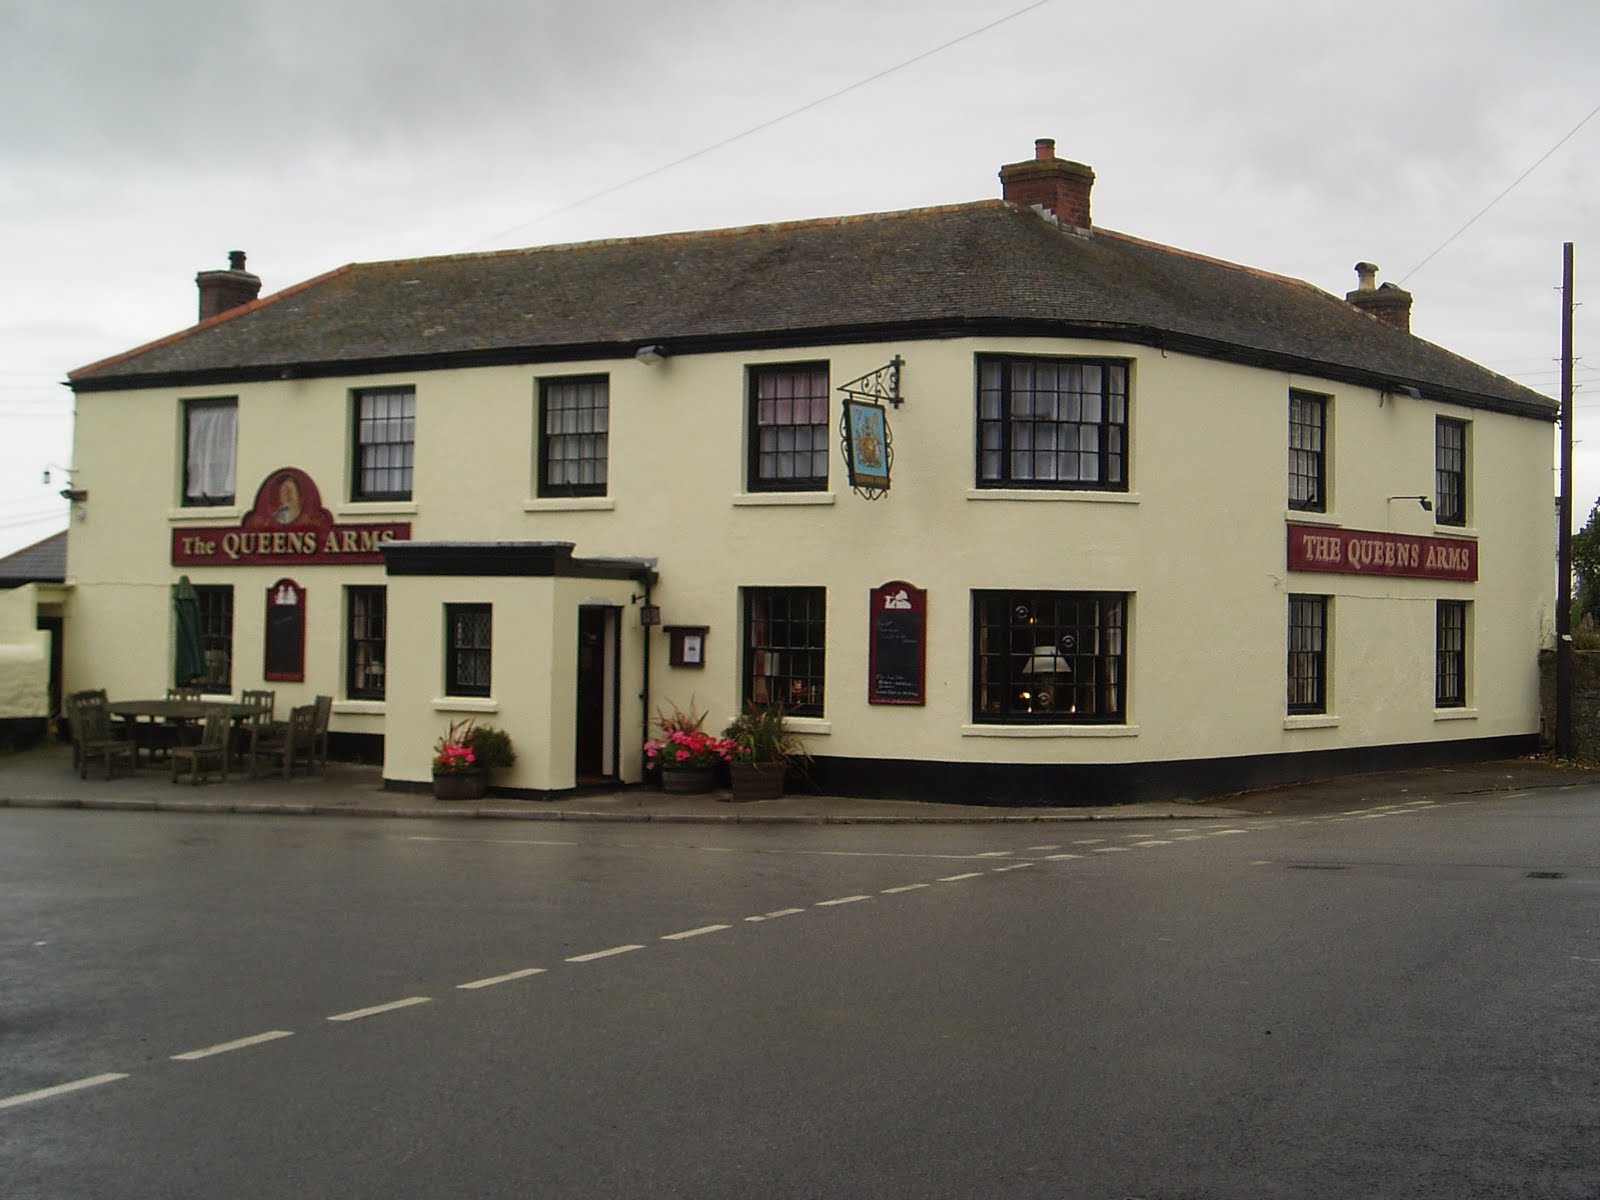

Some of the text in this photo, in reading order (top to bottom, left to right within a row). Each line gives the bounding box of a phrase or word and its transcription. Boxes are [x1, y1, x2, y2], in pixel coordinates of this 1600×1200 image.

[182, 537, 217, 555] The
[222, 532, 317, 559] QUEENS
[1303, 535, 1470, 571] THE QUEENS ARMS
